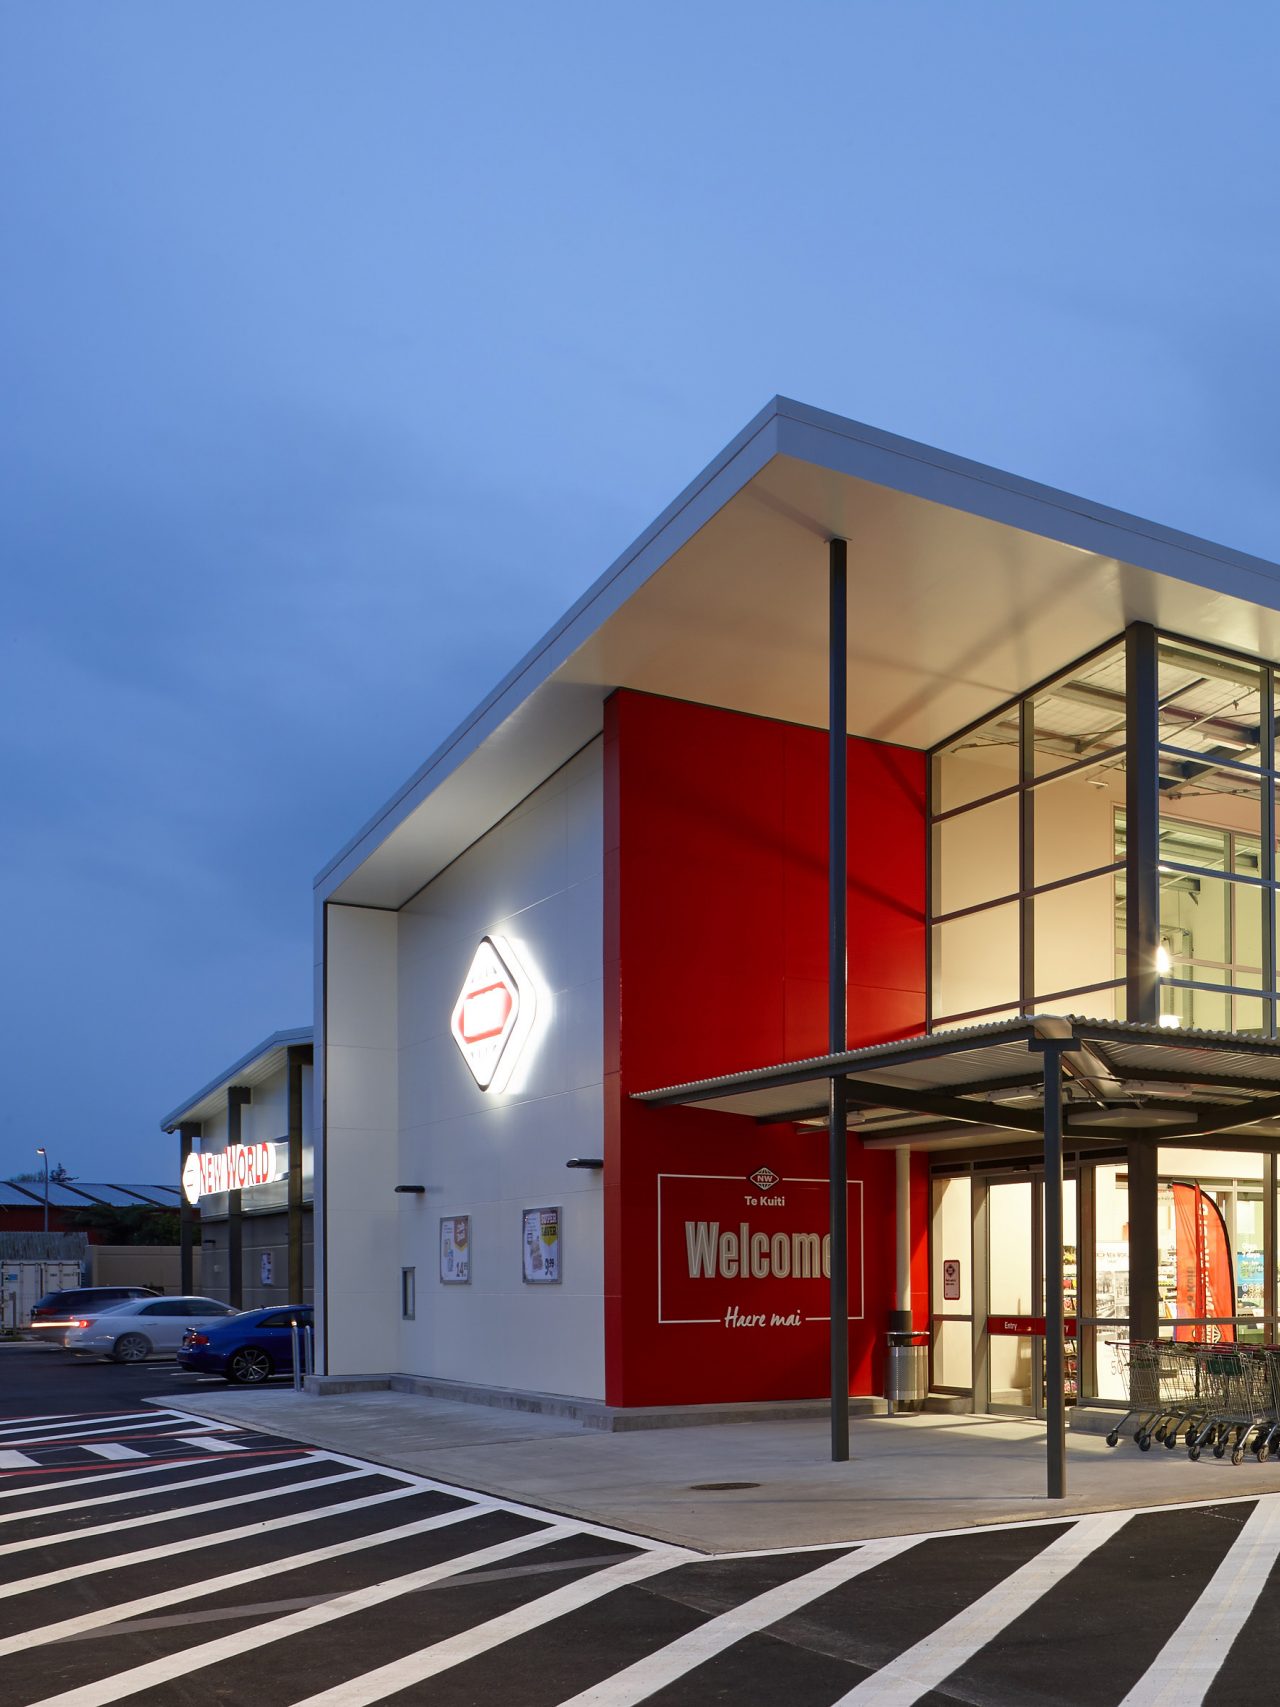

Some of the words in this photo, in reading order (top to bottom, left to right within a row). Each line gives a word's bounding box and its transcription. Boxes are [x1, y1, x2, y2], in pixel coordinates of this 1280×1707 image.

[199, 1152, 223, 1194] NEW
[224, 1141, 269, 1190] WORLD
[757, 1174, 773, 1182] NW
[744, 1195, 758, 1206] Te
[760, 1196, 785, 1207] Kuiti
[724, 1306, 766, 1328] Haere
[770, 1309, 802, 1327] mai
[1004, 1321, 1018, 1331] Entry
